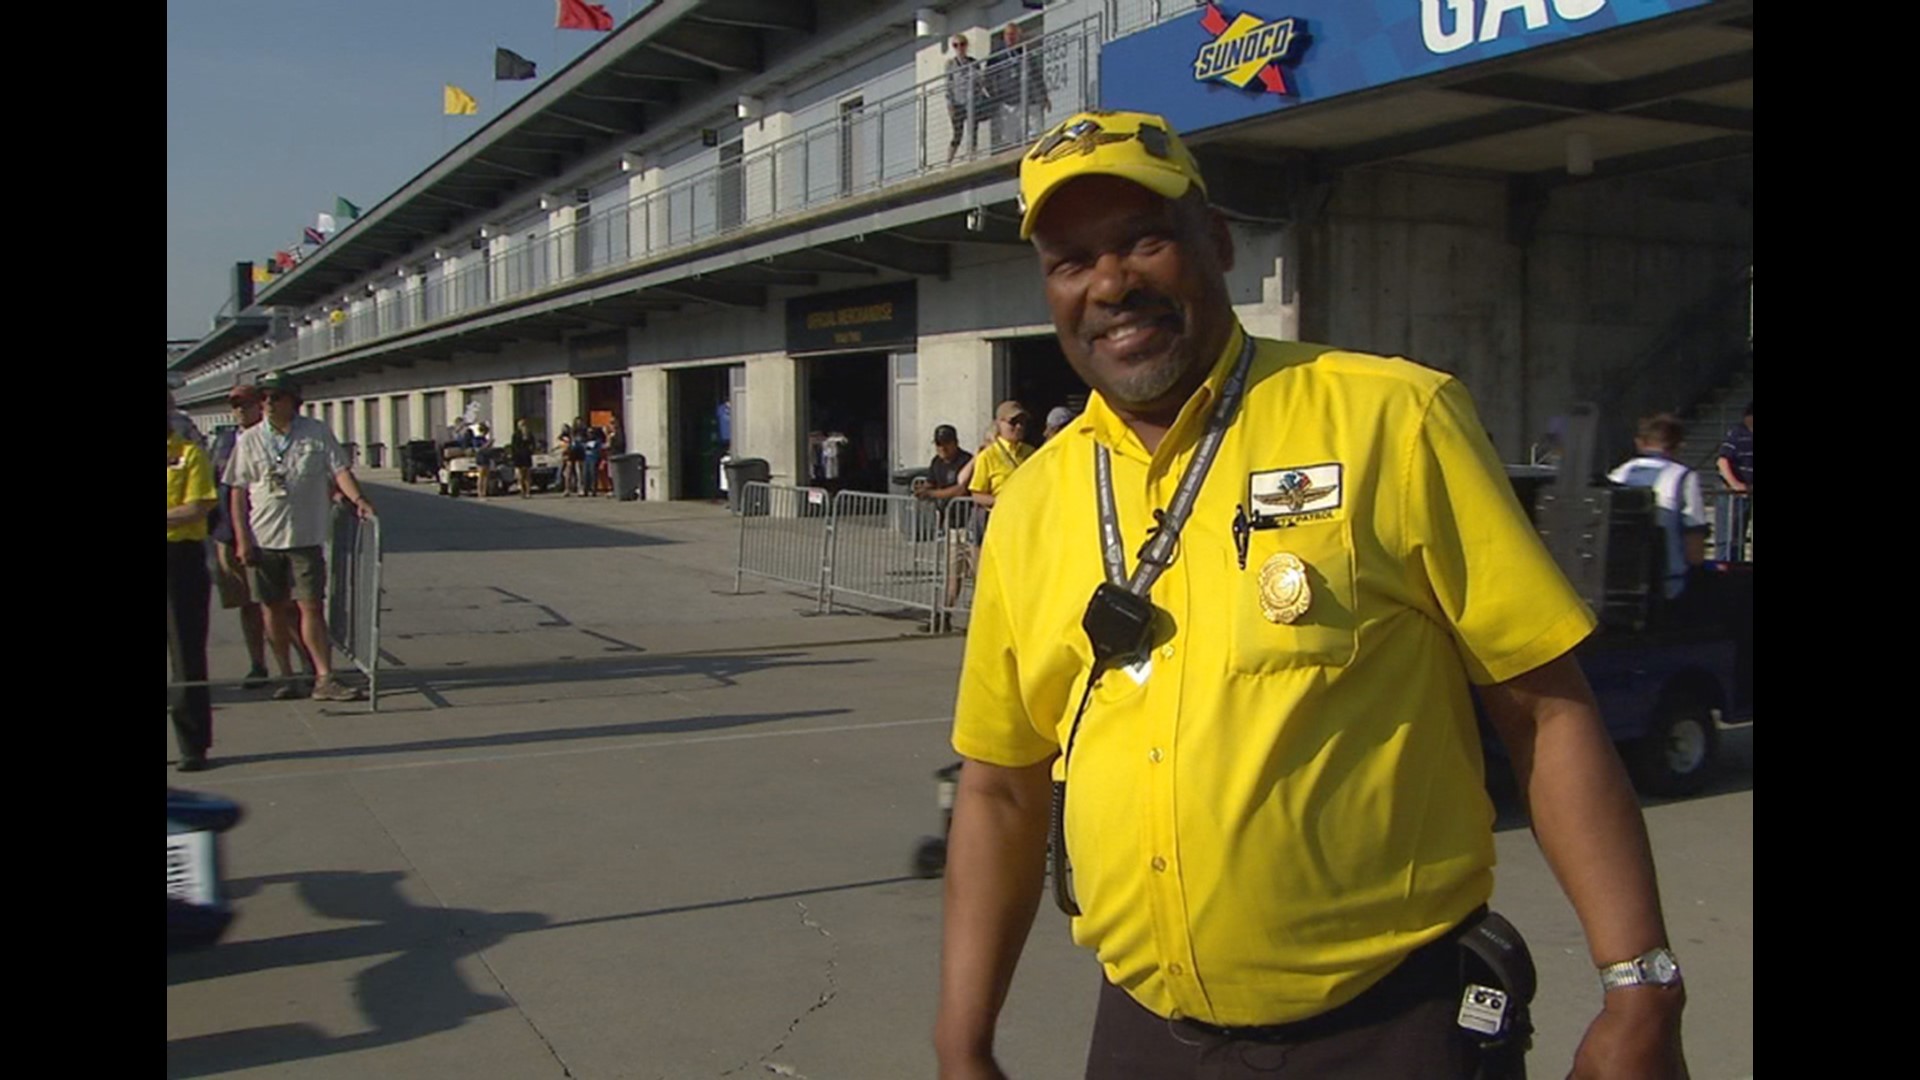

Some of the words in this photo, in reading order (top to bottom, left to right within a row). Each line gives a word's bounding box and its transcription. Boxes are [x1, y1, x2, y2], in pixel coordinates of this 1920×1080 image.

[1198, 22, 1290, 76] SUNOCO
[1421, 0, 1606, 54] GA
[1295, 511, 1335, 523] PATROL
